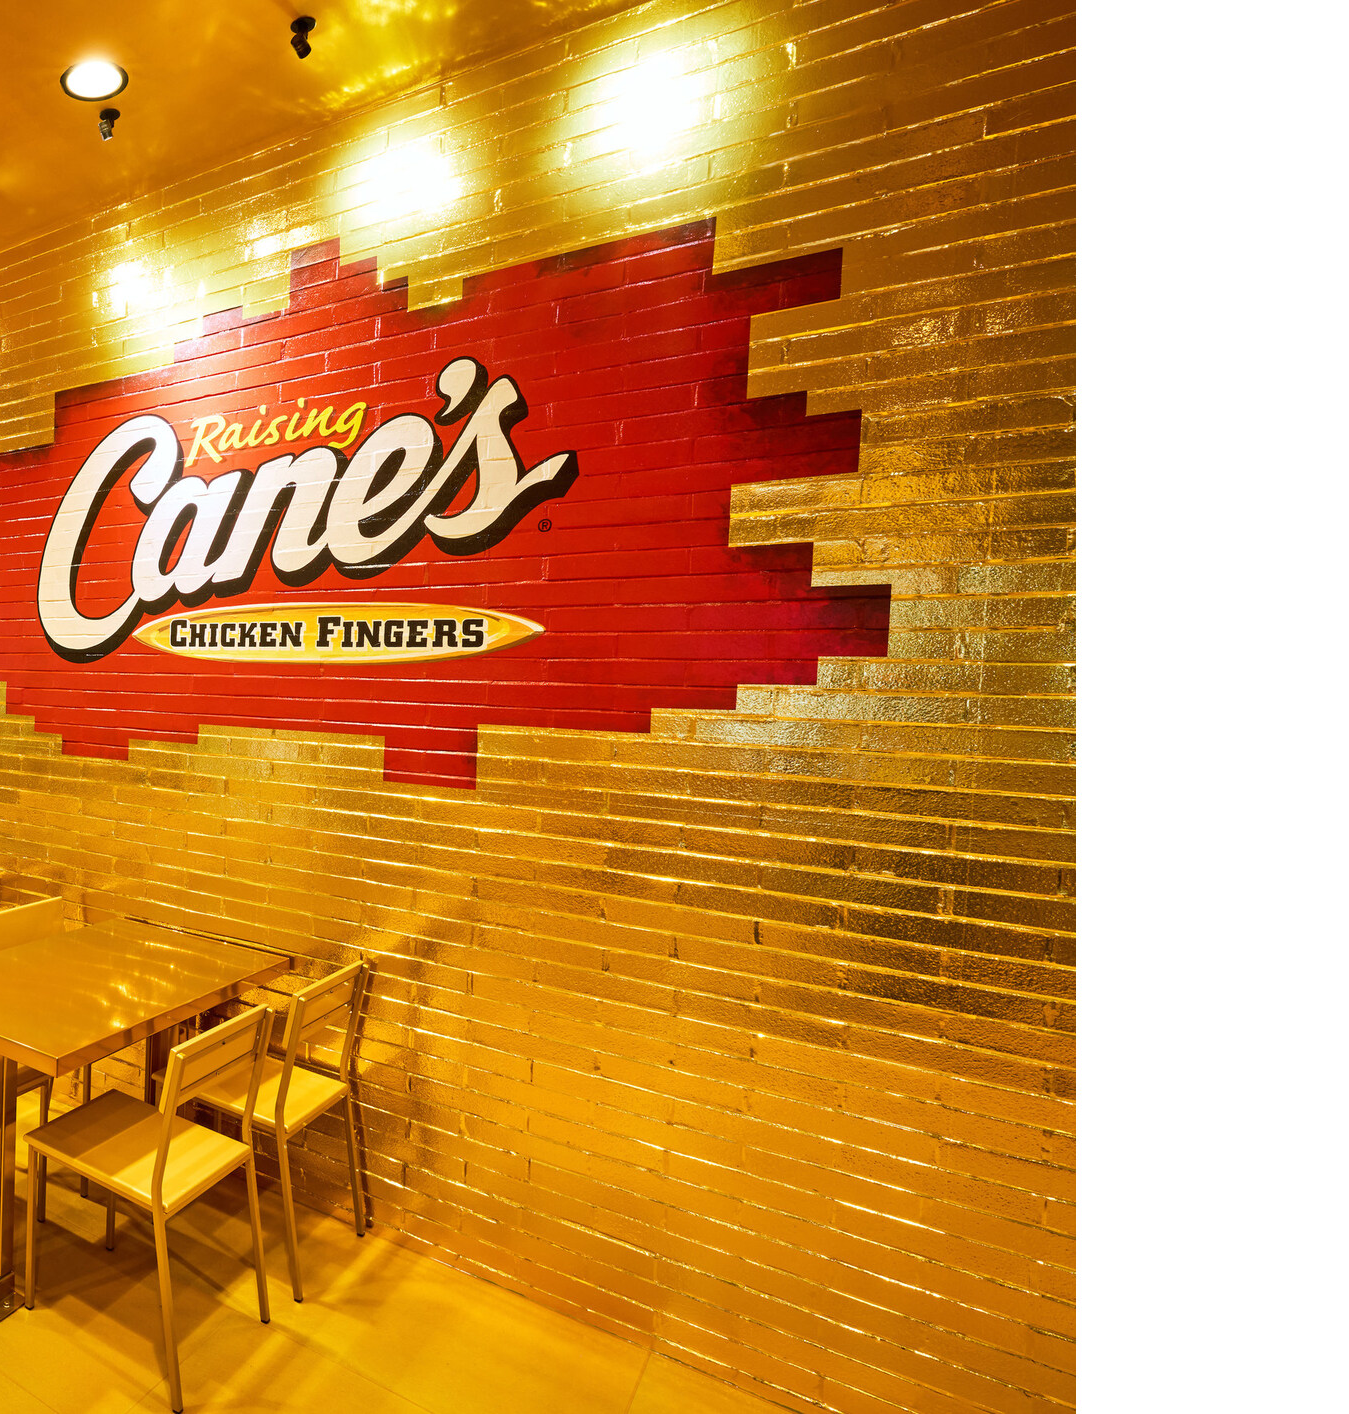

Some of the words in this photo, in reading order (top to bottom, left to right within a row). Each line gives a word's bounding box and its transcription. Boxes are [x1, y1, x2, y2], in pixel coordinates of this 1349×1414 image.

[184, 397, 367, 468] Raising
[37, 356, 579, 663] Cane's
[170, 619, 303, 648] CHICKEN
[316, 616, 484, 648] FINGERS
